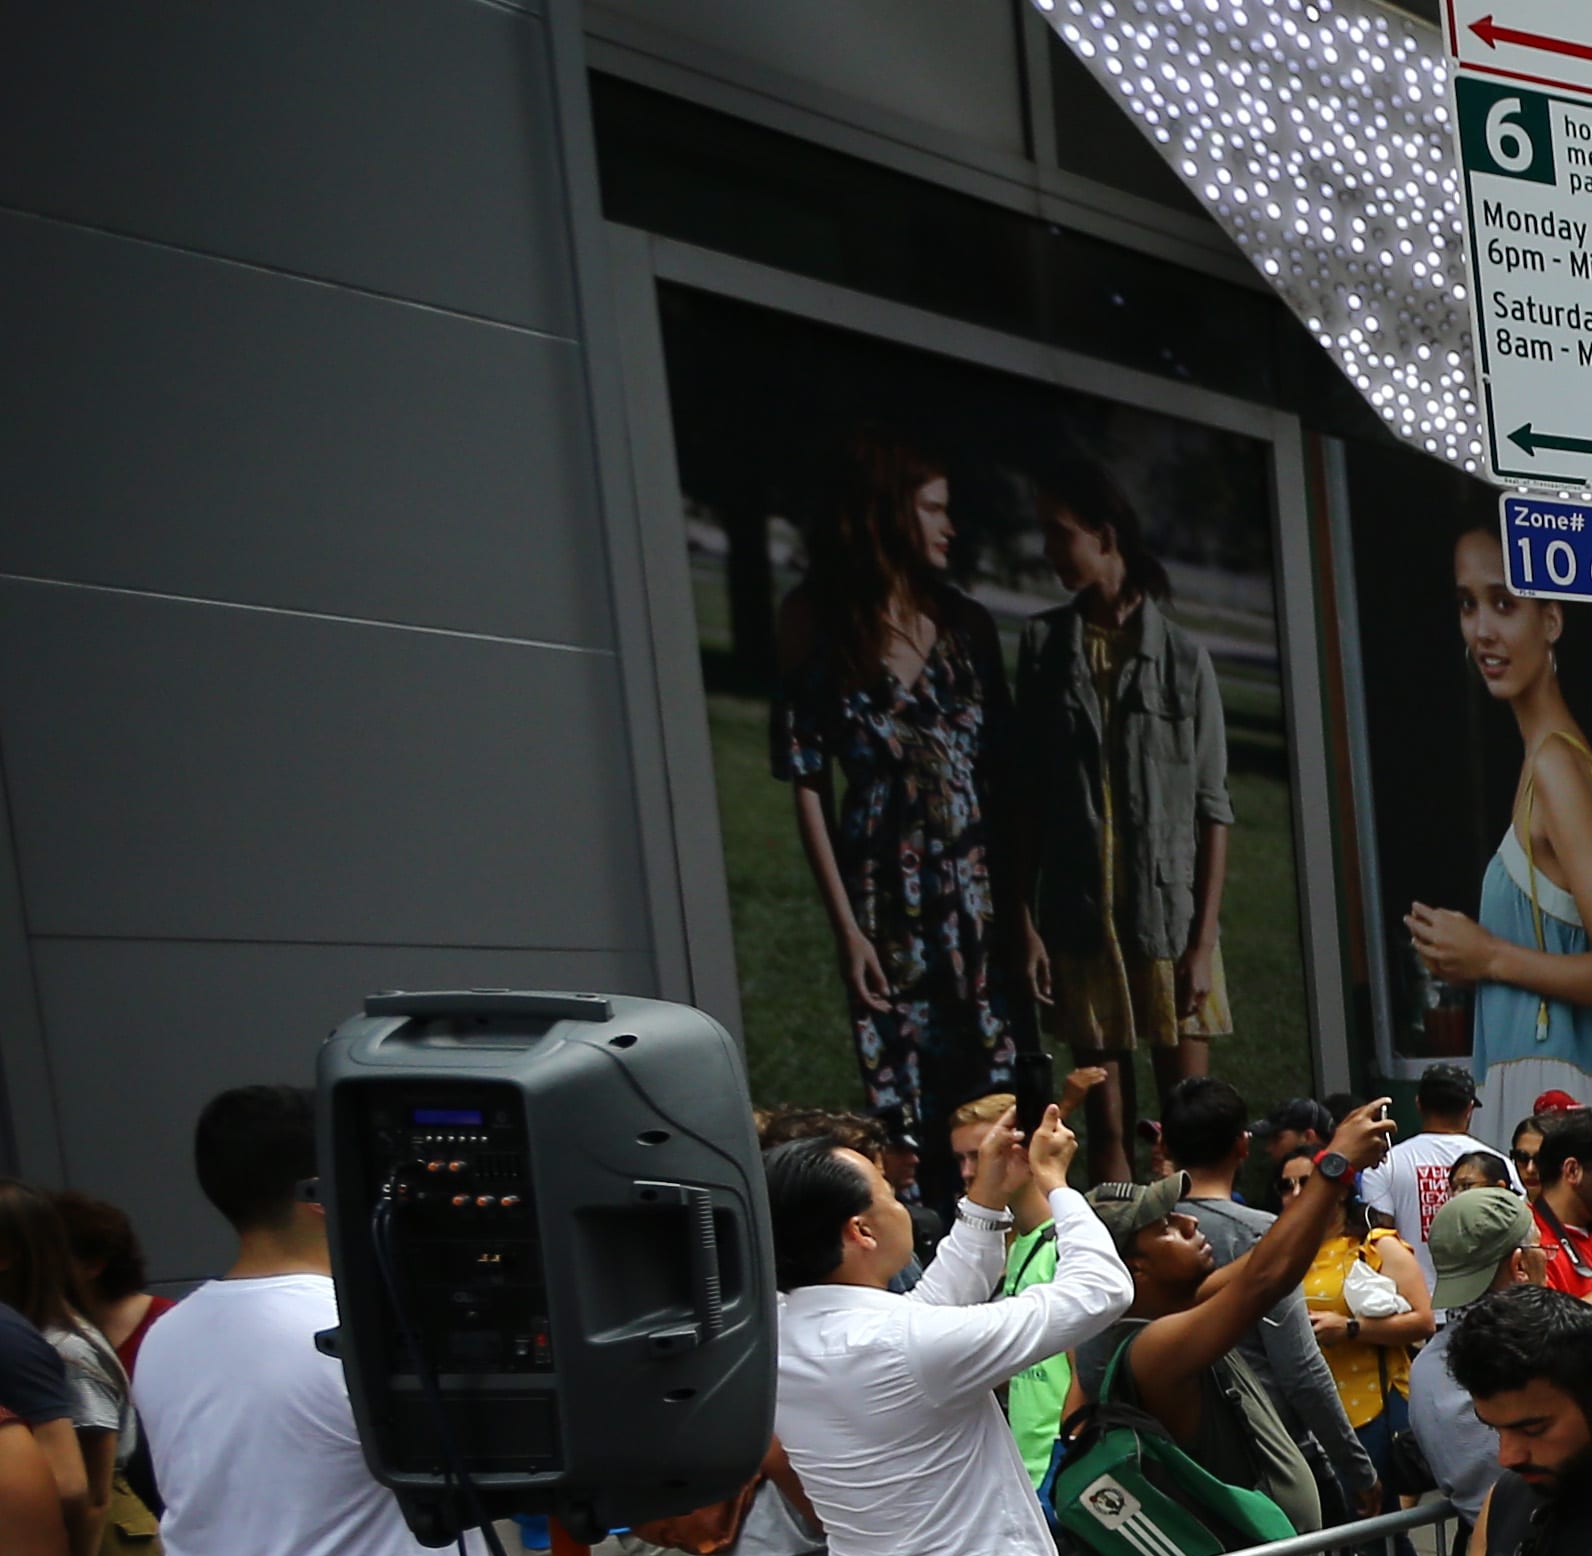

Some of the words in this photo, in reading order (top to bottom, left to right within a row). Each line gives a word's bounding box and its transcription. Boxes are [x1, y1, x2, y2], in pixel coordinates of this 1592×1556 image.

[1485, 97, 1534, 173] 6
[1483, 200, 1588, 249] Monday
[1487, 238, 1546, 273] 6pm
[1496, 328, 1554, 362] 8am
[1514, 505, 1585, 532] Zone#
